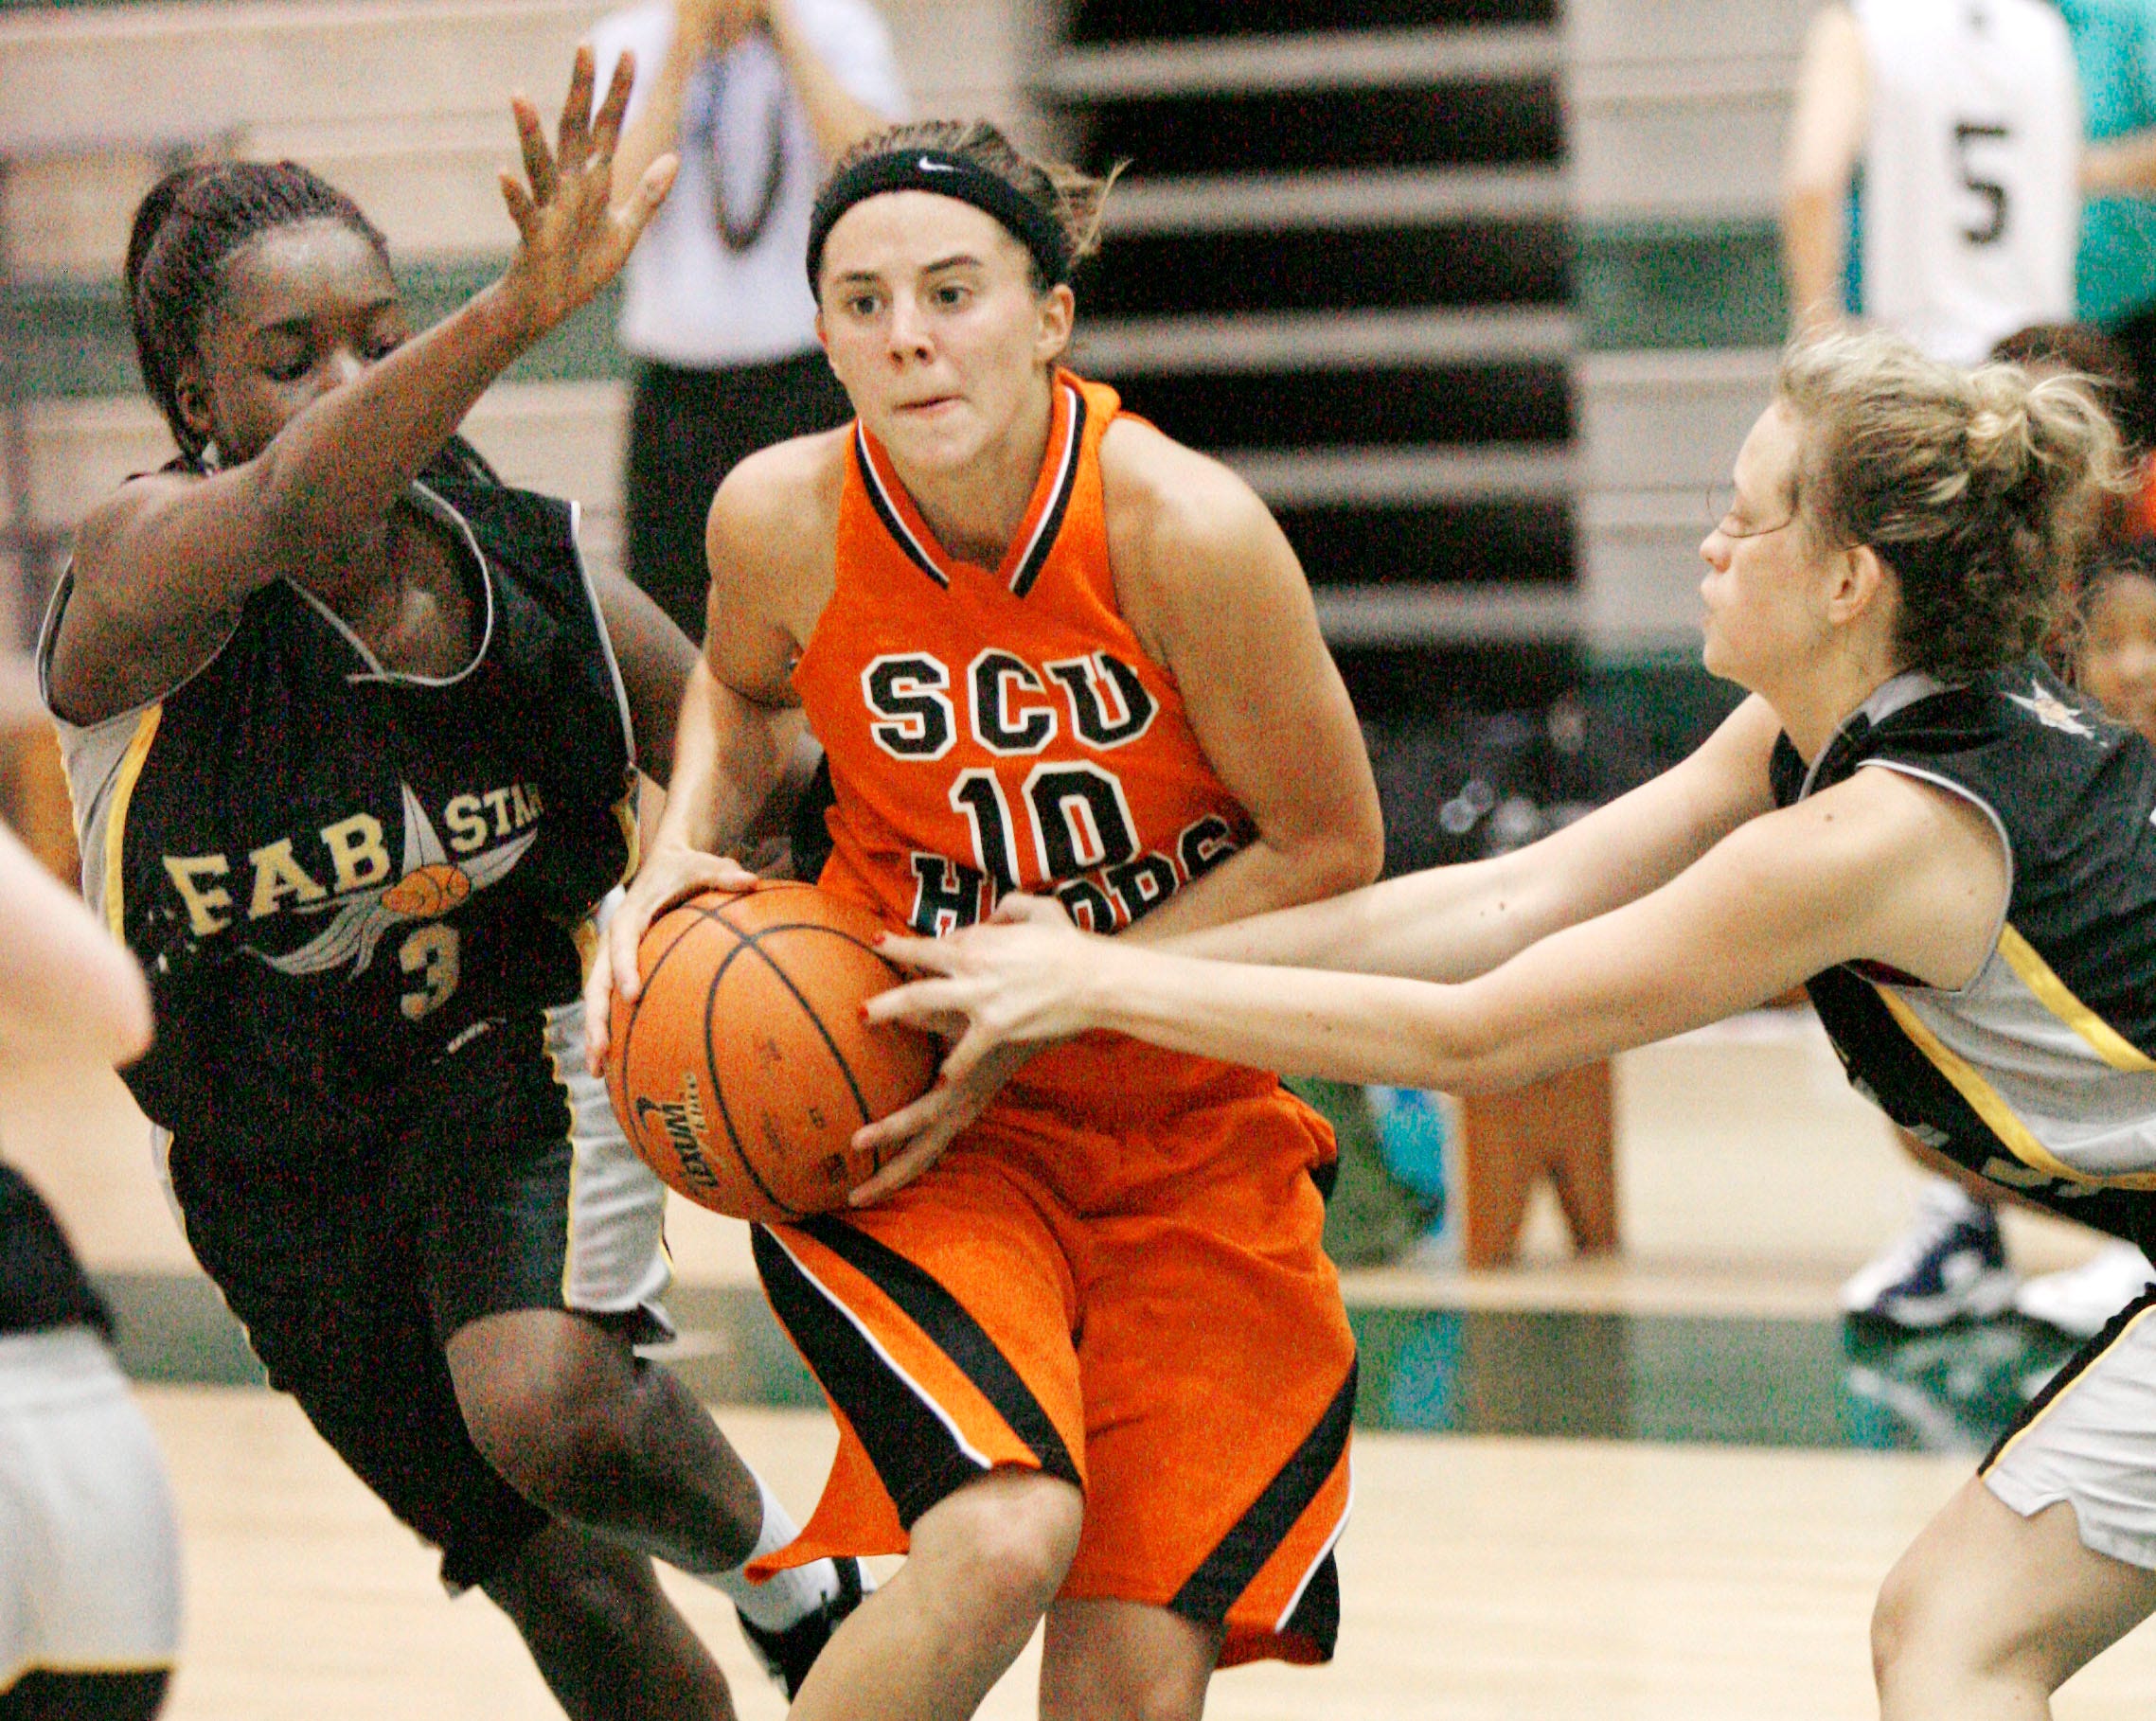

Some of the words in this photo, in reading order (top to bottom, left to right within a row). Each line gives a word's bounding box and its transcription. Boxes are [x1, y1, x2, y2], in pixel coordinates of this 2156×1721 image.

[1951, 118, 2013, 251] 5
[861, 648, 1160, 761] SCU
[162, 811, 391, 938] FAB
[948, 759, 1142, 892] 10
[399, 923, 462, 1021] 3
